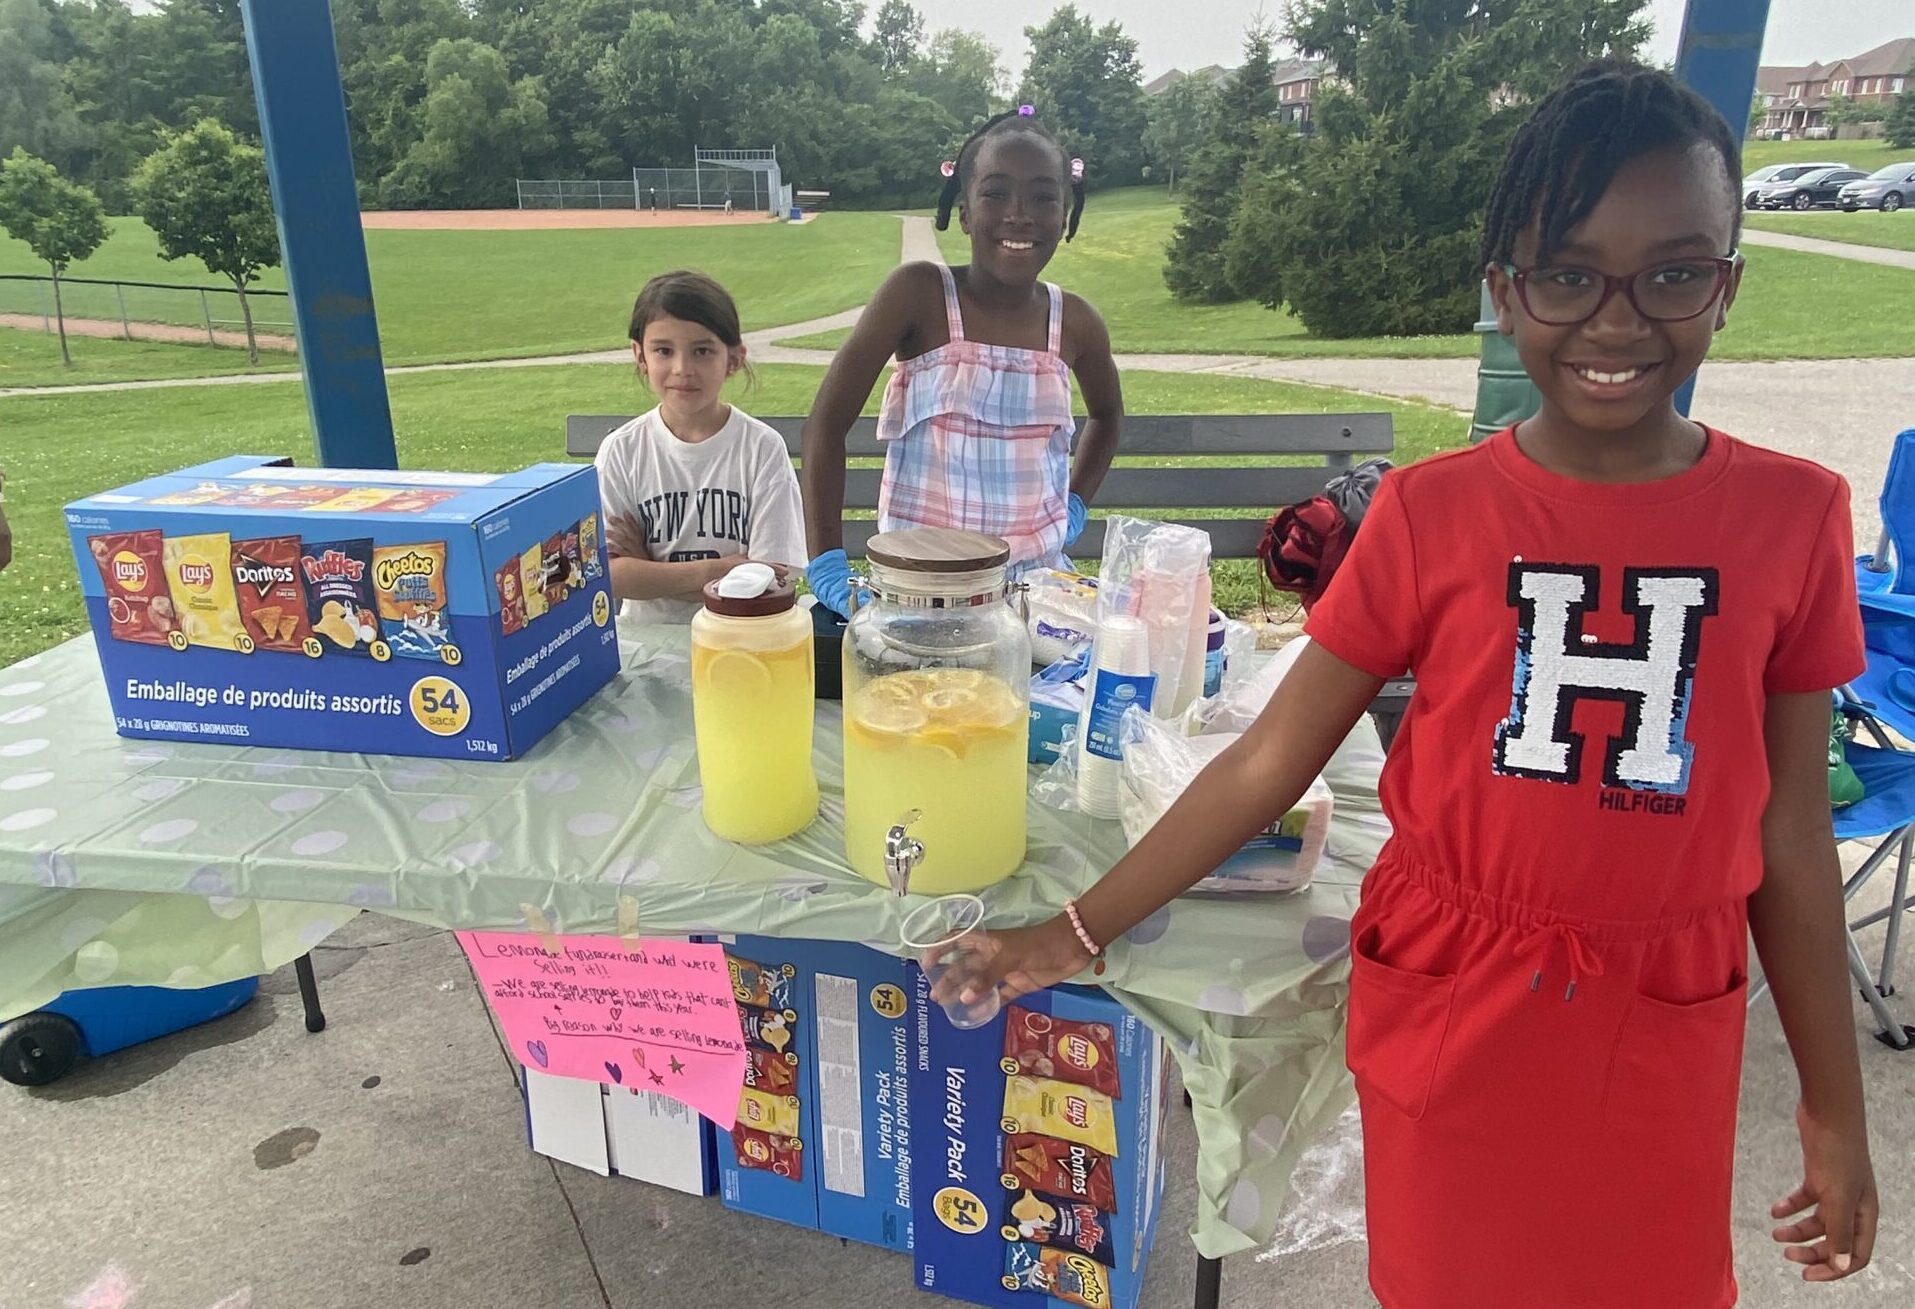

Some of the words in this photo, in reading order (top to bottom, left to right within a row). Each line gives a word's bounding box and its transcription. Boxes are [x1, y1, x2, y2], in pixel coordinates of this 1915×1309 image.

[116, 561, 145, 582] Lay's
[181, 563, 212, 586] Lay's
[236, 566, 294, 583] Doritos
[301, 550, 365, 584] Ruffles
[377, 551, 433, 590] Cheetos
[170, 633, 185, 647] 10
[238, 637, 252, 648] 10
[305, 641, 320, 654] 16
[376, 645, 385, 657] 8
[443, 648, 459, 661] 10
[507, 653, 539, 684] Emballage
[1492, 562, 1720, 796] H
[127, 679, 217, 707] Emballage
[223, 684, 245, 705] de
[250, 688, 326, 710] produits
[331, 692, 402, 715] assortis
[421, 687, 459, 714] 54
[428, 716, 456, 727] sacs
[1599, 791, 1686, 817] HILFIGER
[877, 988, 893, 1011] 54
[917, 1005, 928, 1044] FLAVOURED
[891, 1026, 907, 1074] assortis
[919, 1045, 929, 1071] SNACKS
[1067, 1036, 1088, 1068] Lay's
[1003, 1060, 1017, 1072] 10
[875, 1070, 891, 1107] Pack
[892, 1075, 911, 1128] produits
[943, 1067, 967, 1135] Variety
[1003, 1120, 1017, 1132] 10
[1067, 1097, 1088, 1127] Lay's
[878, 1107, 894, 1159] Variety
[894, 1128, 908, 1145] de
[947, 1136, 967, 1182] Pack
[1070, 1145, 1087, 1195] Doritos
[894, 1146, 912, 1208] Emballage
[1003, 1176, 1016, 1188] 16
[942, 1196, 952, 1219] Bags
[953, 1197, 977, 1227] 54
[1071, 1203, 1104, 1254] Ruffles
[1005, 1277, 1017, 1288] 10
[1067, 1256, 1103, 1303] Cheetos
